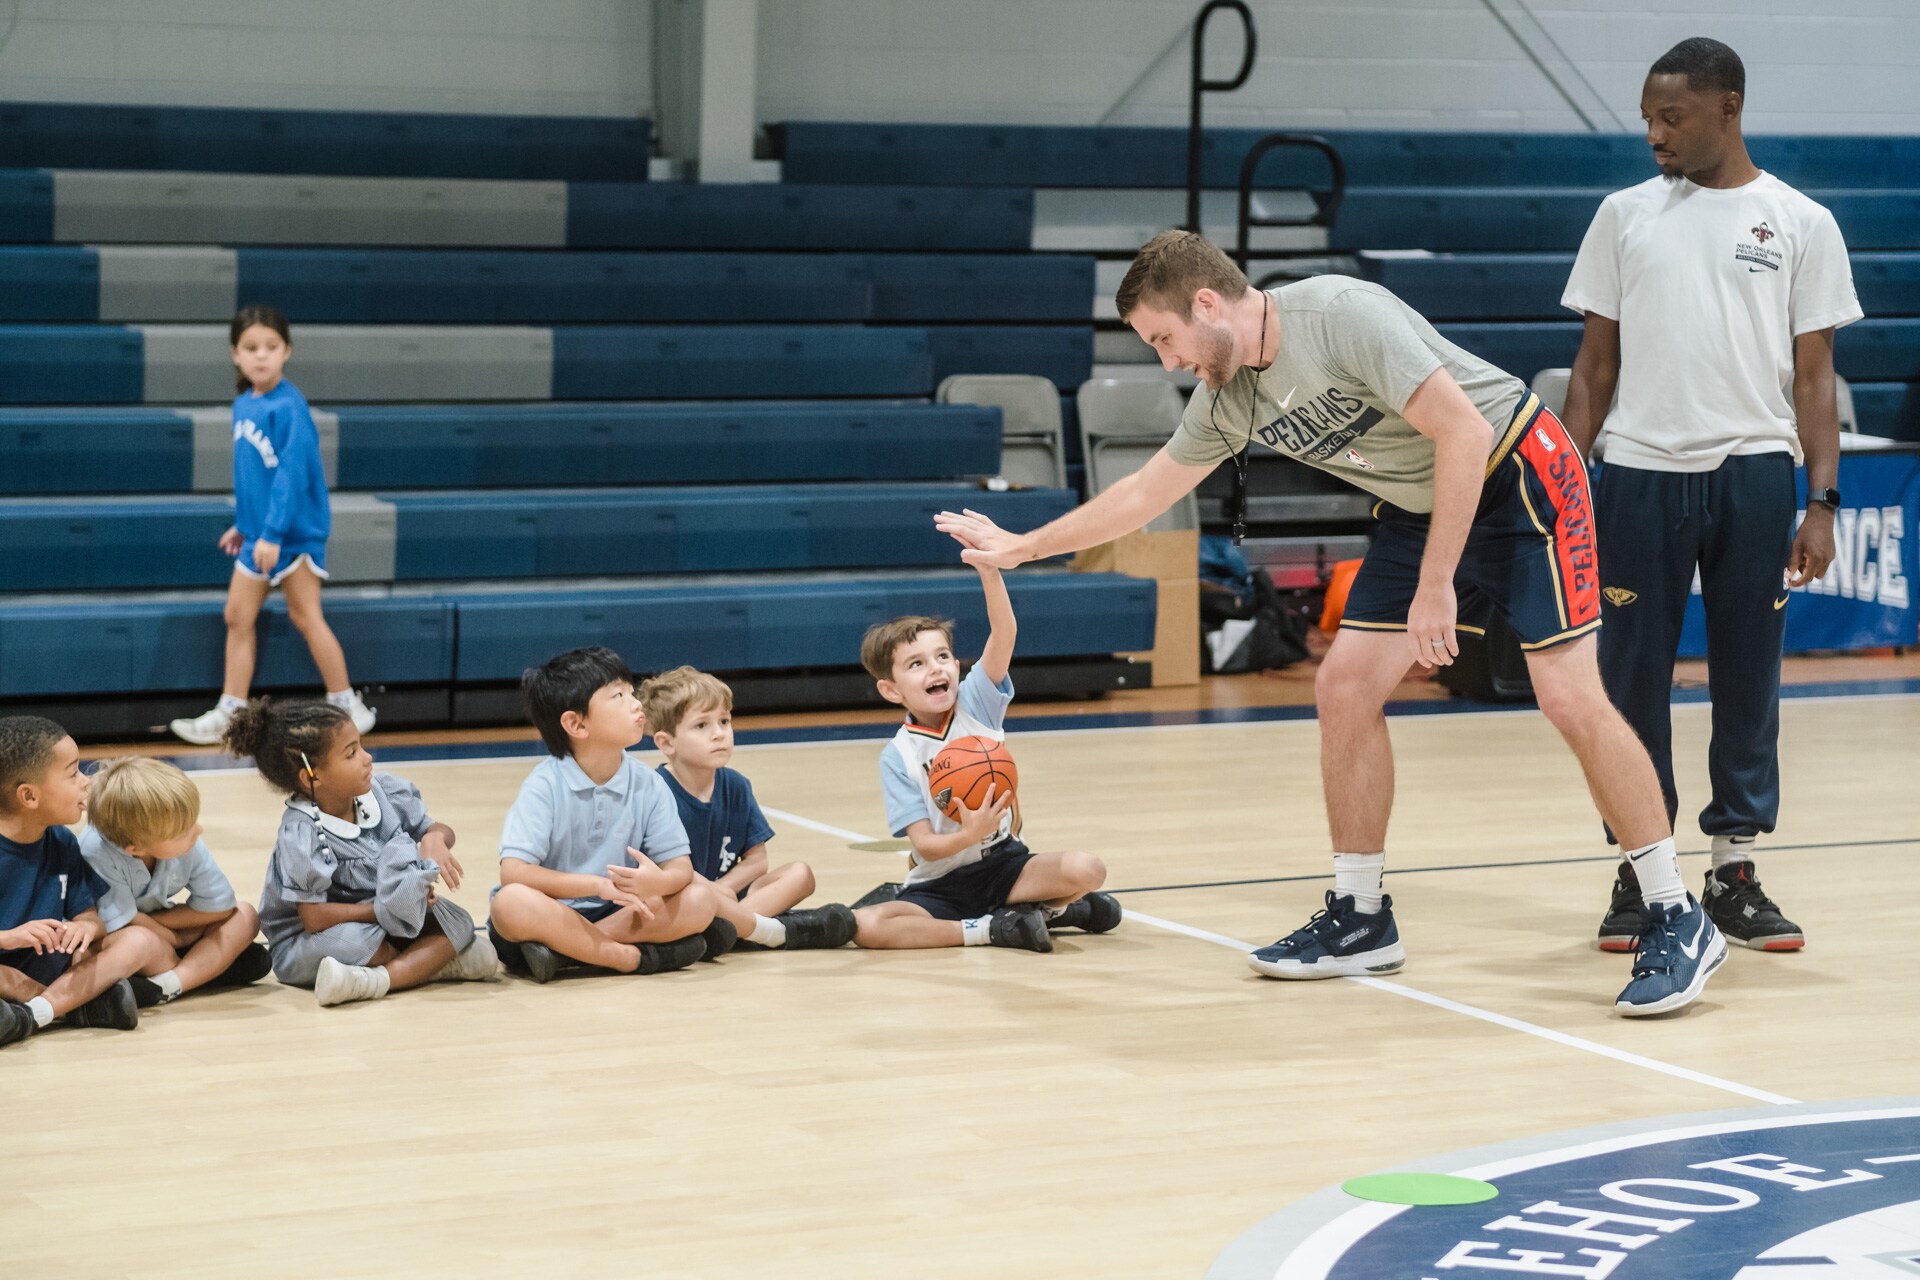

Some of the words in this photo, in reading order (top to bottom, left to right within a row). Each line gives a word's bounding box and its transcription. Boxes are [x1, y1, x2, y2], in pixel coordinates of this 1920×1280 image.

[1735, 248, 1768, 259] PELICANS
[1753, 245, 1783, 260] ORLEANS
[1257, 387, 1363, 453] PELICANS
[1549, 450, 1594, 593] PELICANS
